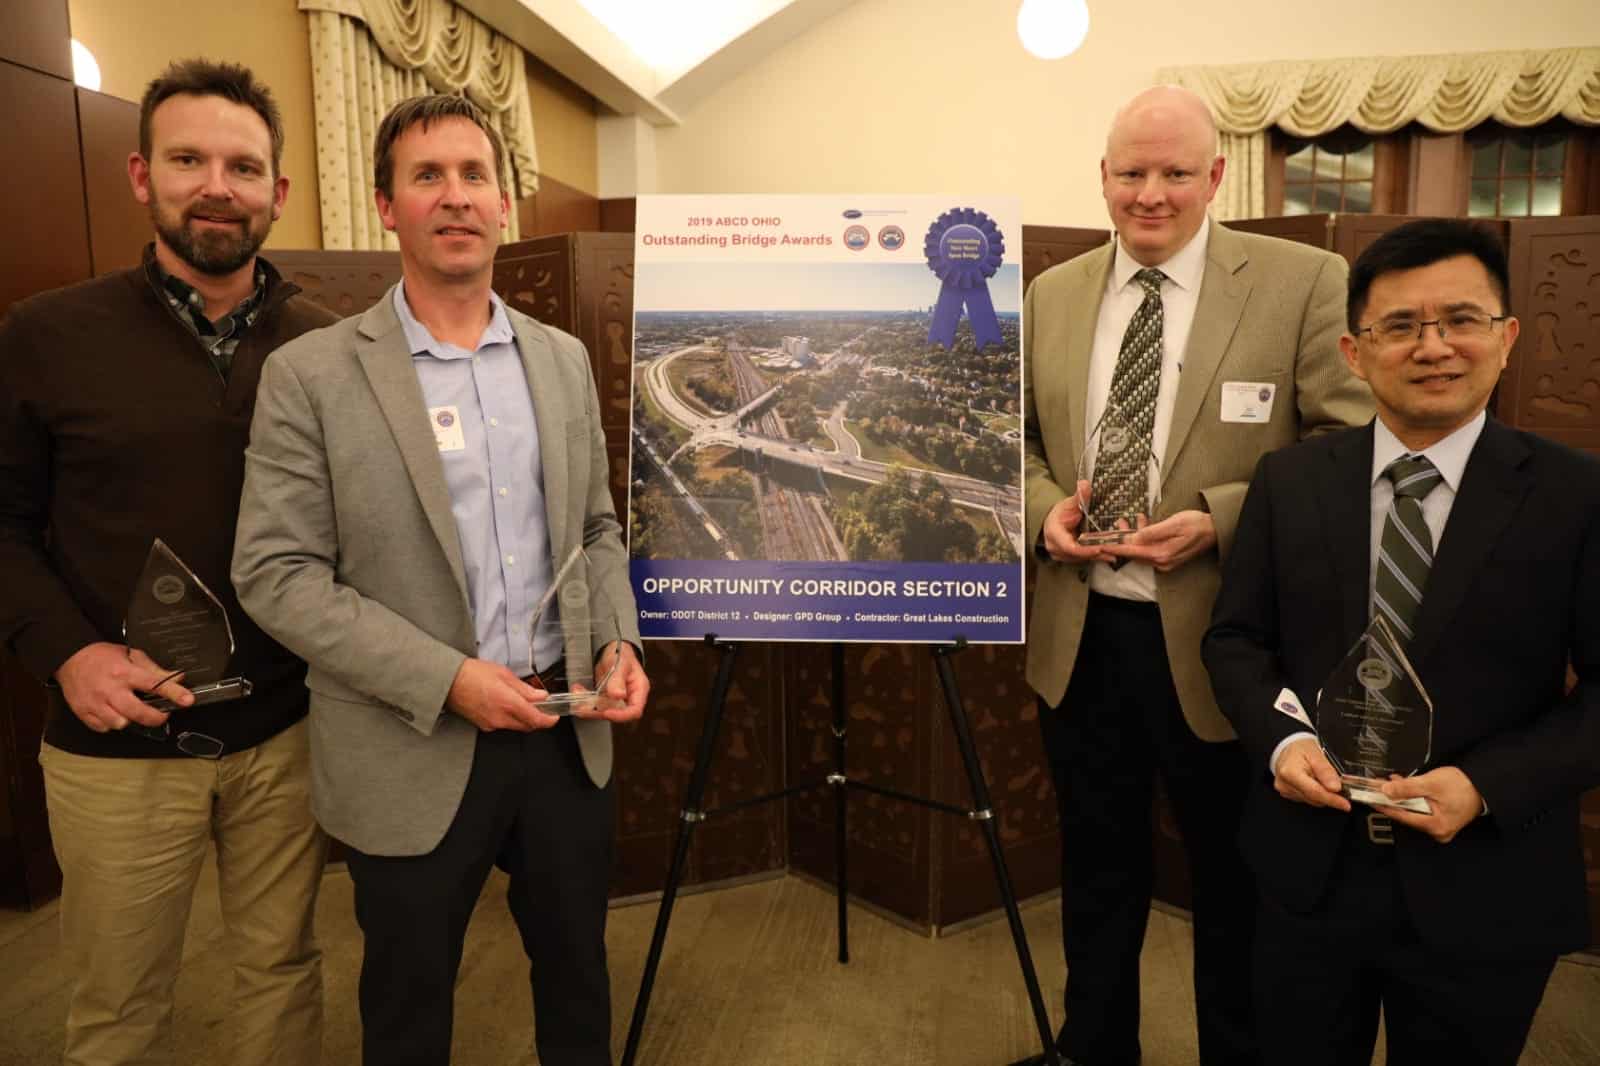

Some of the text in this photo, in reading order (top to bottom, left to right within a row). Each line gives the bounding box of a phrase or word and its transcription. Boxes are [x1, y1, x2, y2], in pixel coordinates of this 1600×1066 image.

[687, 216, 781, 226] 2019 ABCD OHIO
[642, 234, 727, 247] Outstanding
[731, 233, 777, 248] Bridge
[780, 234, 833, 246] Awards
[643, 578, 1008, 597] OPPORTUNITY CORRIDOR SECTION 2
[640, 610, 1009, 623] Owner: ODOT District 12 Designer: GPD Group Contractor: Great Lakes Construction
